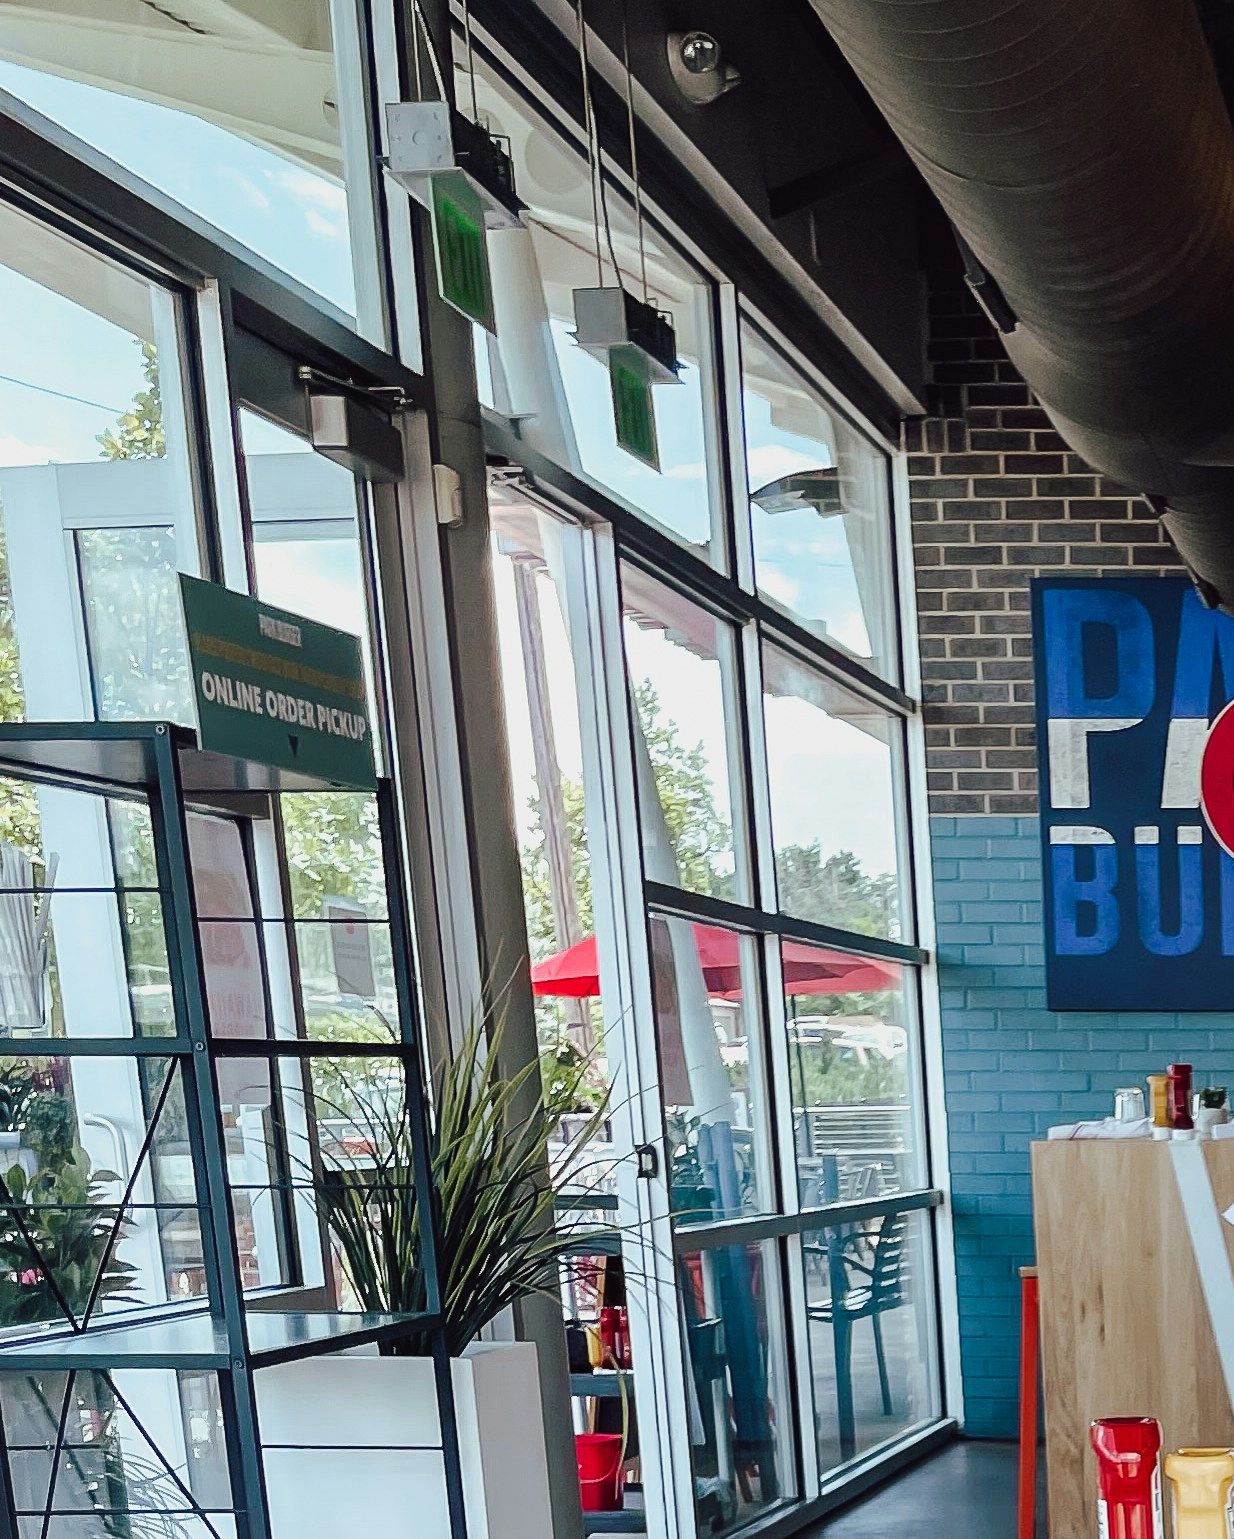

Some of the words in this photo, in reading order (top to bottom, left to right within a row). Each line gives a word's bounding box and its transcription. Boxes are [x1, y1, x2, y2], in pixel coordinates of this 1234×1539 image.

[202, 671, 263, 715] ONLINE
[265, 690, 315, 729] ORDER
[316, 704, 366, 741] PICKUP
